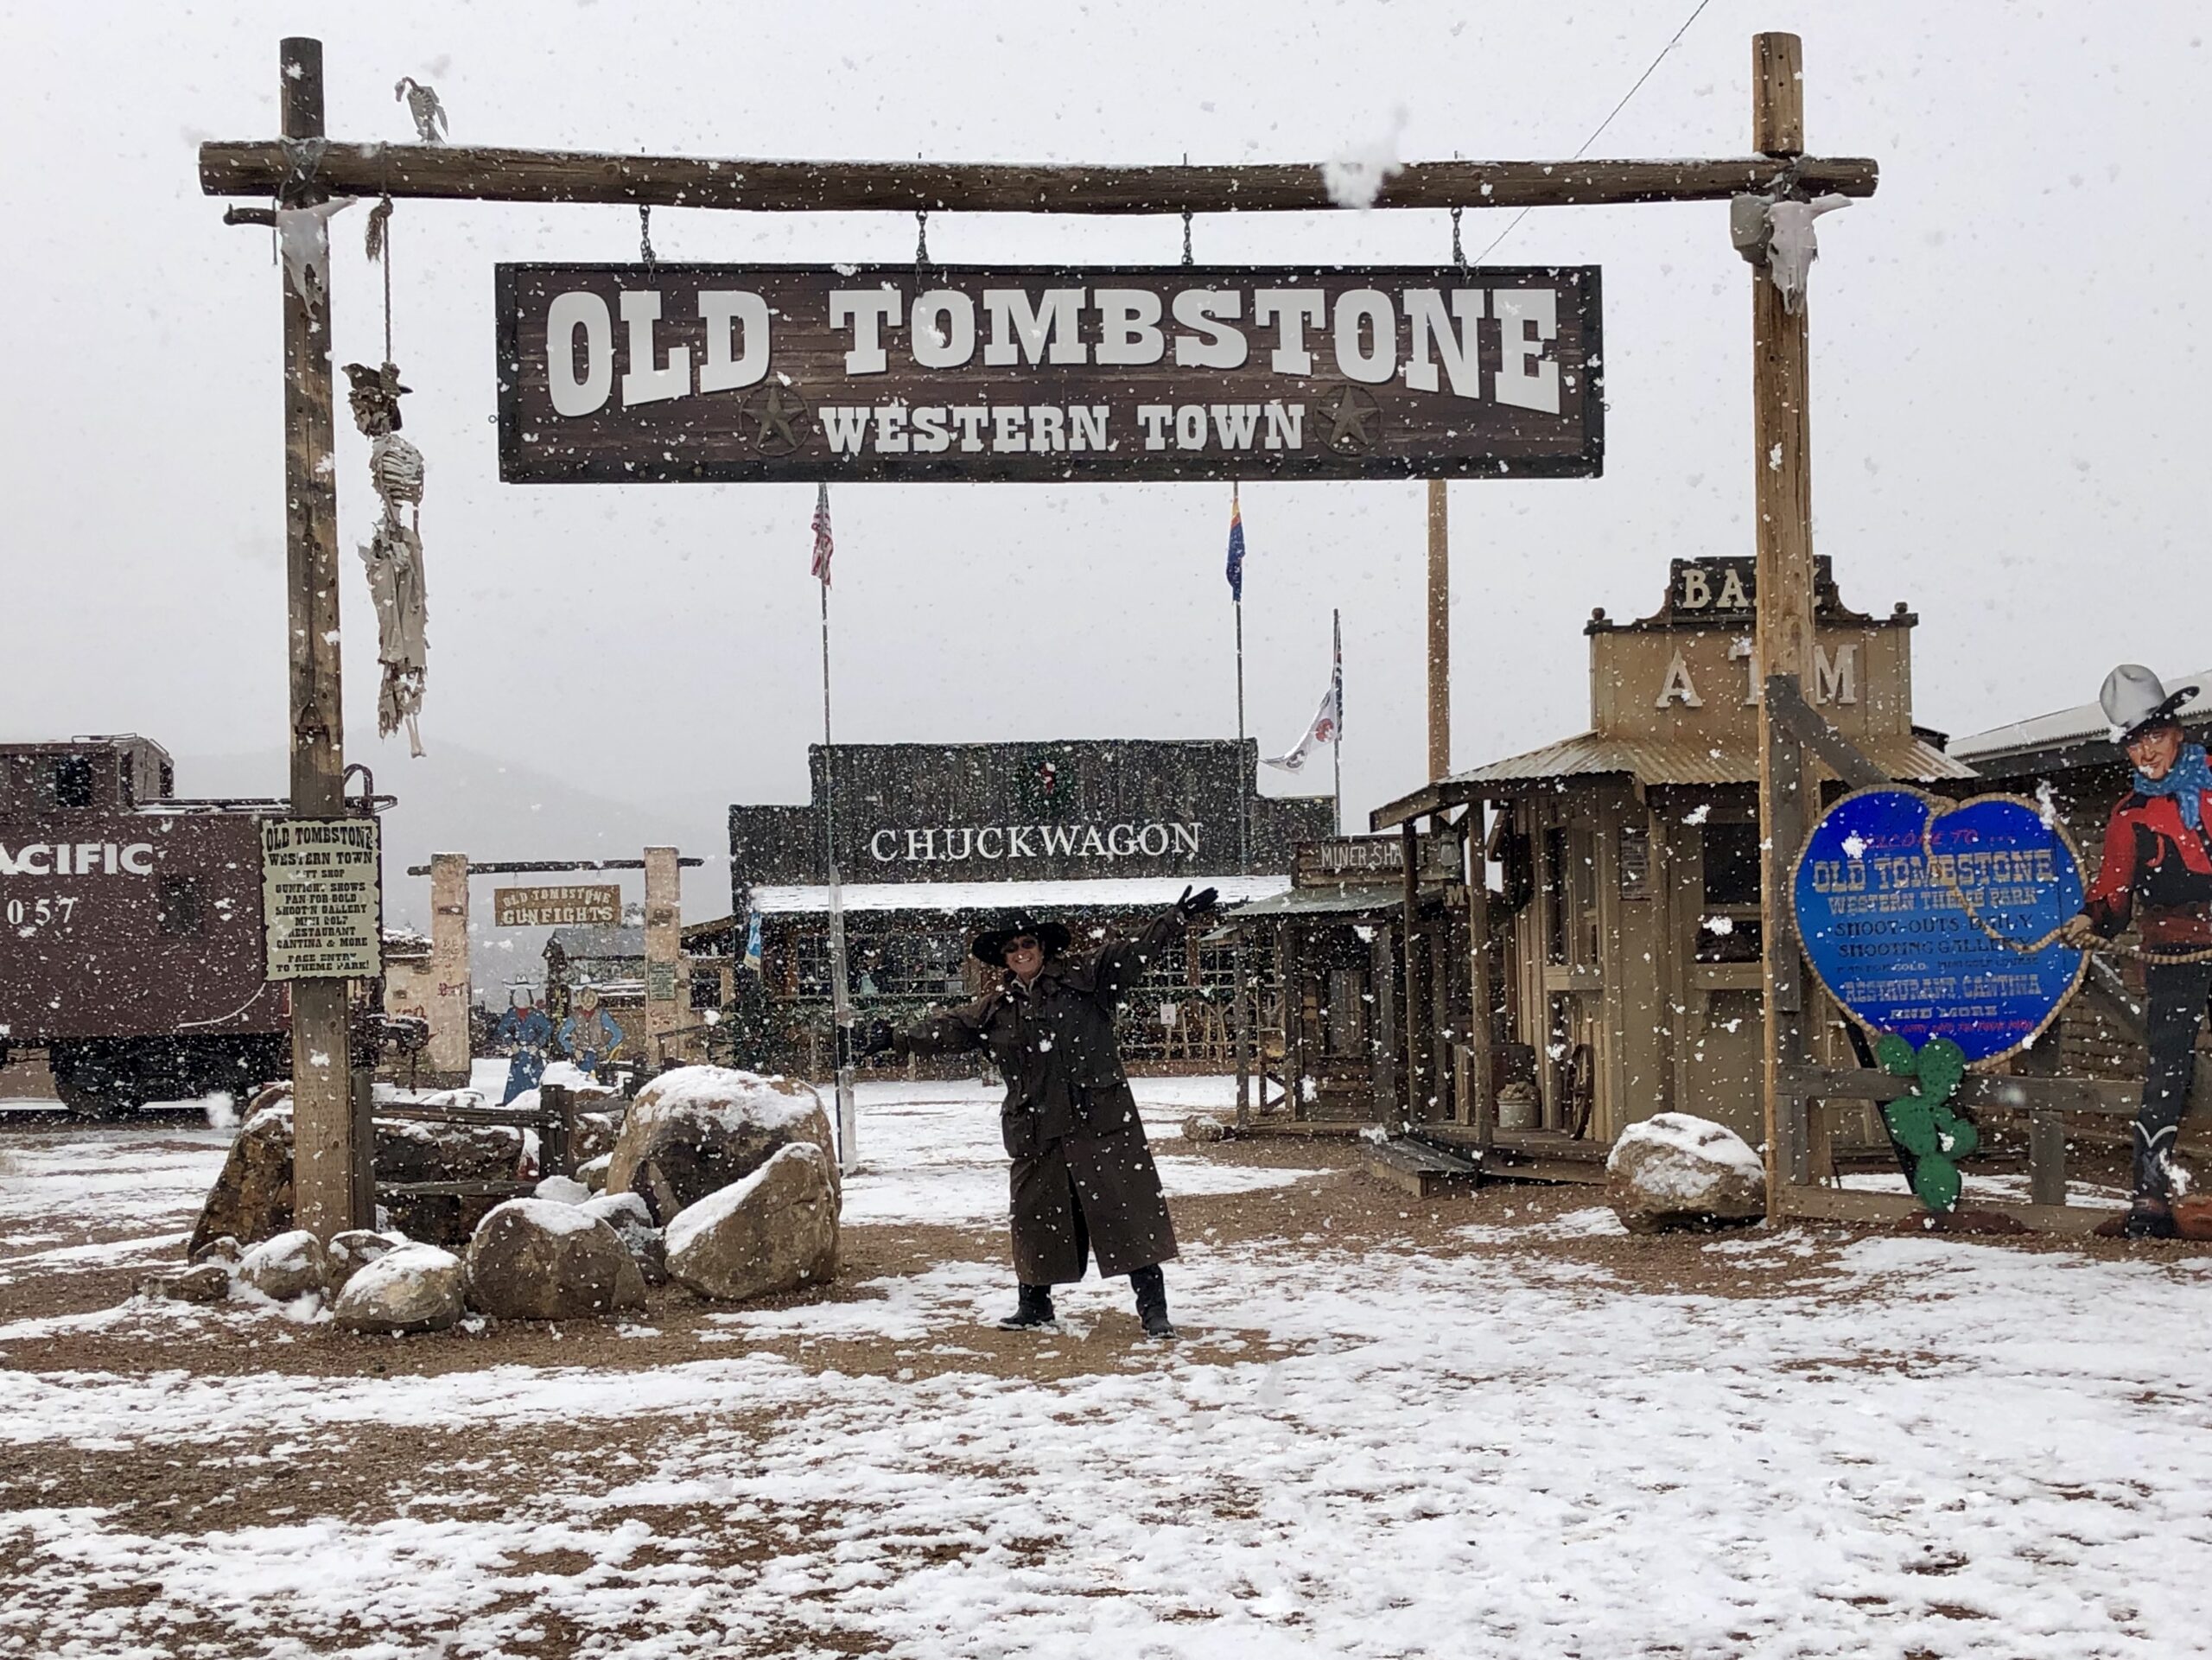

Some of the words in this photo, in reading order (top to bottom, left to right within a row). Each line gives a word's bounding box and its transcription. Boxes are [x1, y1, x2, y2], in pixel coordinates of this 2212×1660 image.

[546, 290, 771, 417] OLD
[829, 288, 1560, 415] TOMBSTONE
[817, 405, 1111, 453] WESTERN
[1137, 404, 1306, 451] TOWN
[266, 827, 289, 852] OLD
[295, 825, 373, 851] TOMBSTONE
[870, 822, 1204, 862] CHUCKWAGON
[268, 852, 331, 866] WESTERN
[336, 851, 373, 865] TOWN
[1321, 845, 1367, 868] MINER
[321, 868, 345, 878] SHOP
[1814, 859, 1867, 894] OLD
[330, 882, 366, 892] SHOWS
[503, 892, 528, 907] OLD
[532, 887, 612, 905] TOMBSTONE
[321, 904, 367, 914] GALLERY
[1827, 892, 1915, 914] WESTERN
[1989, 887, 2037, 906] PARK
[502, 906, 614, 925] GUNFIGHTS
[276, 938, 322, 949] CANTINA
[340, 937, 367, 947] MORE
[295, 963, 333, 972] THEME
